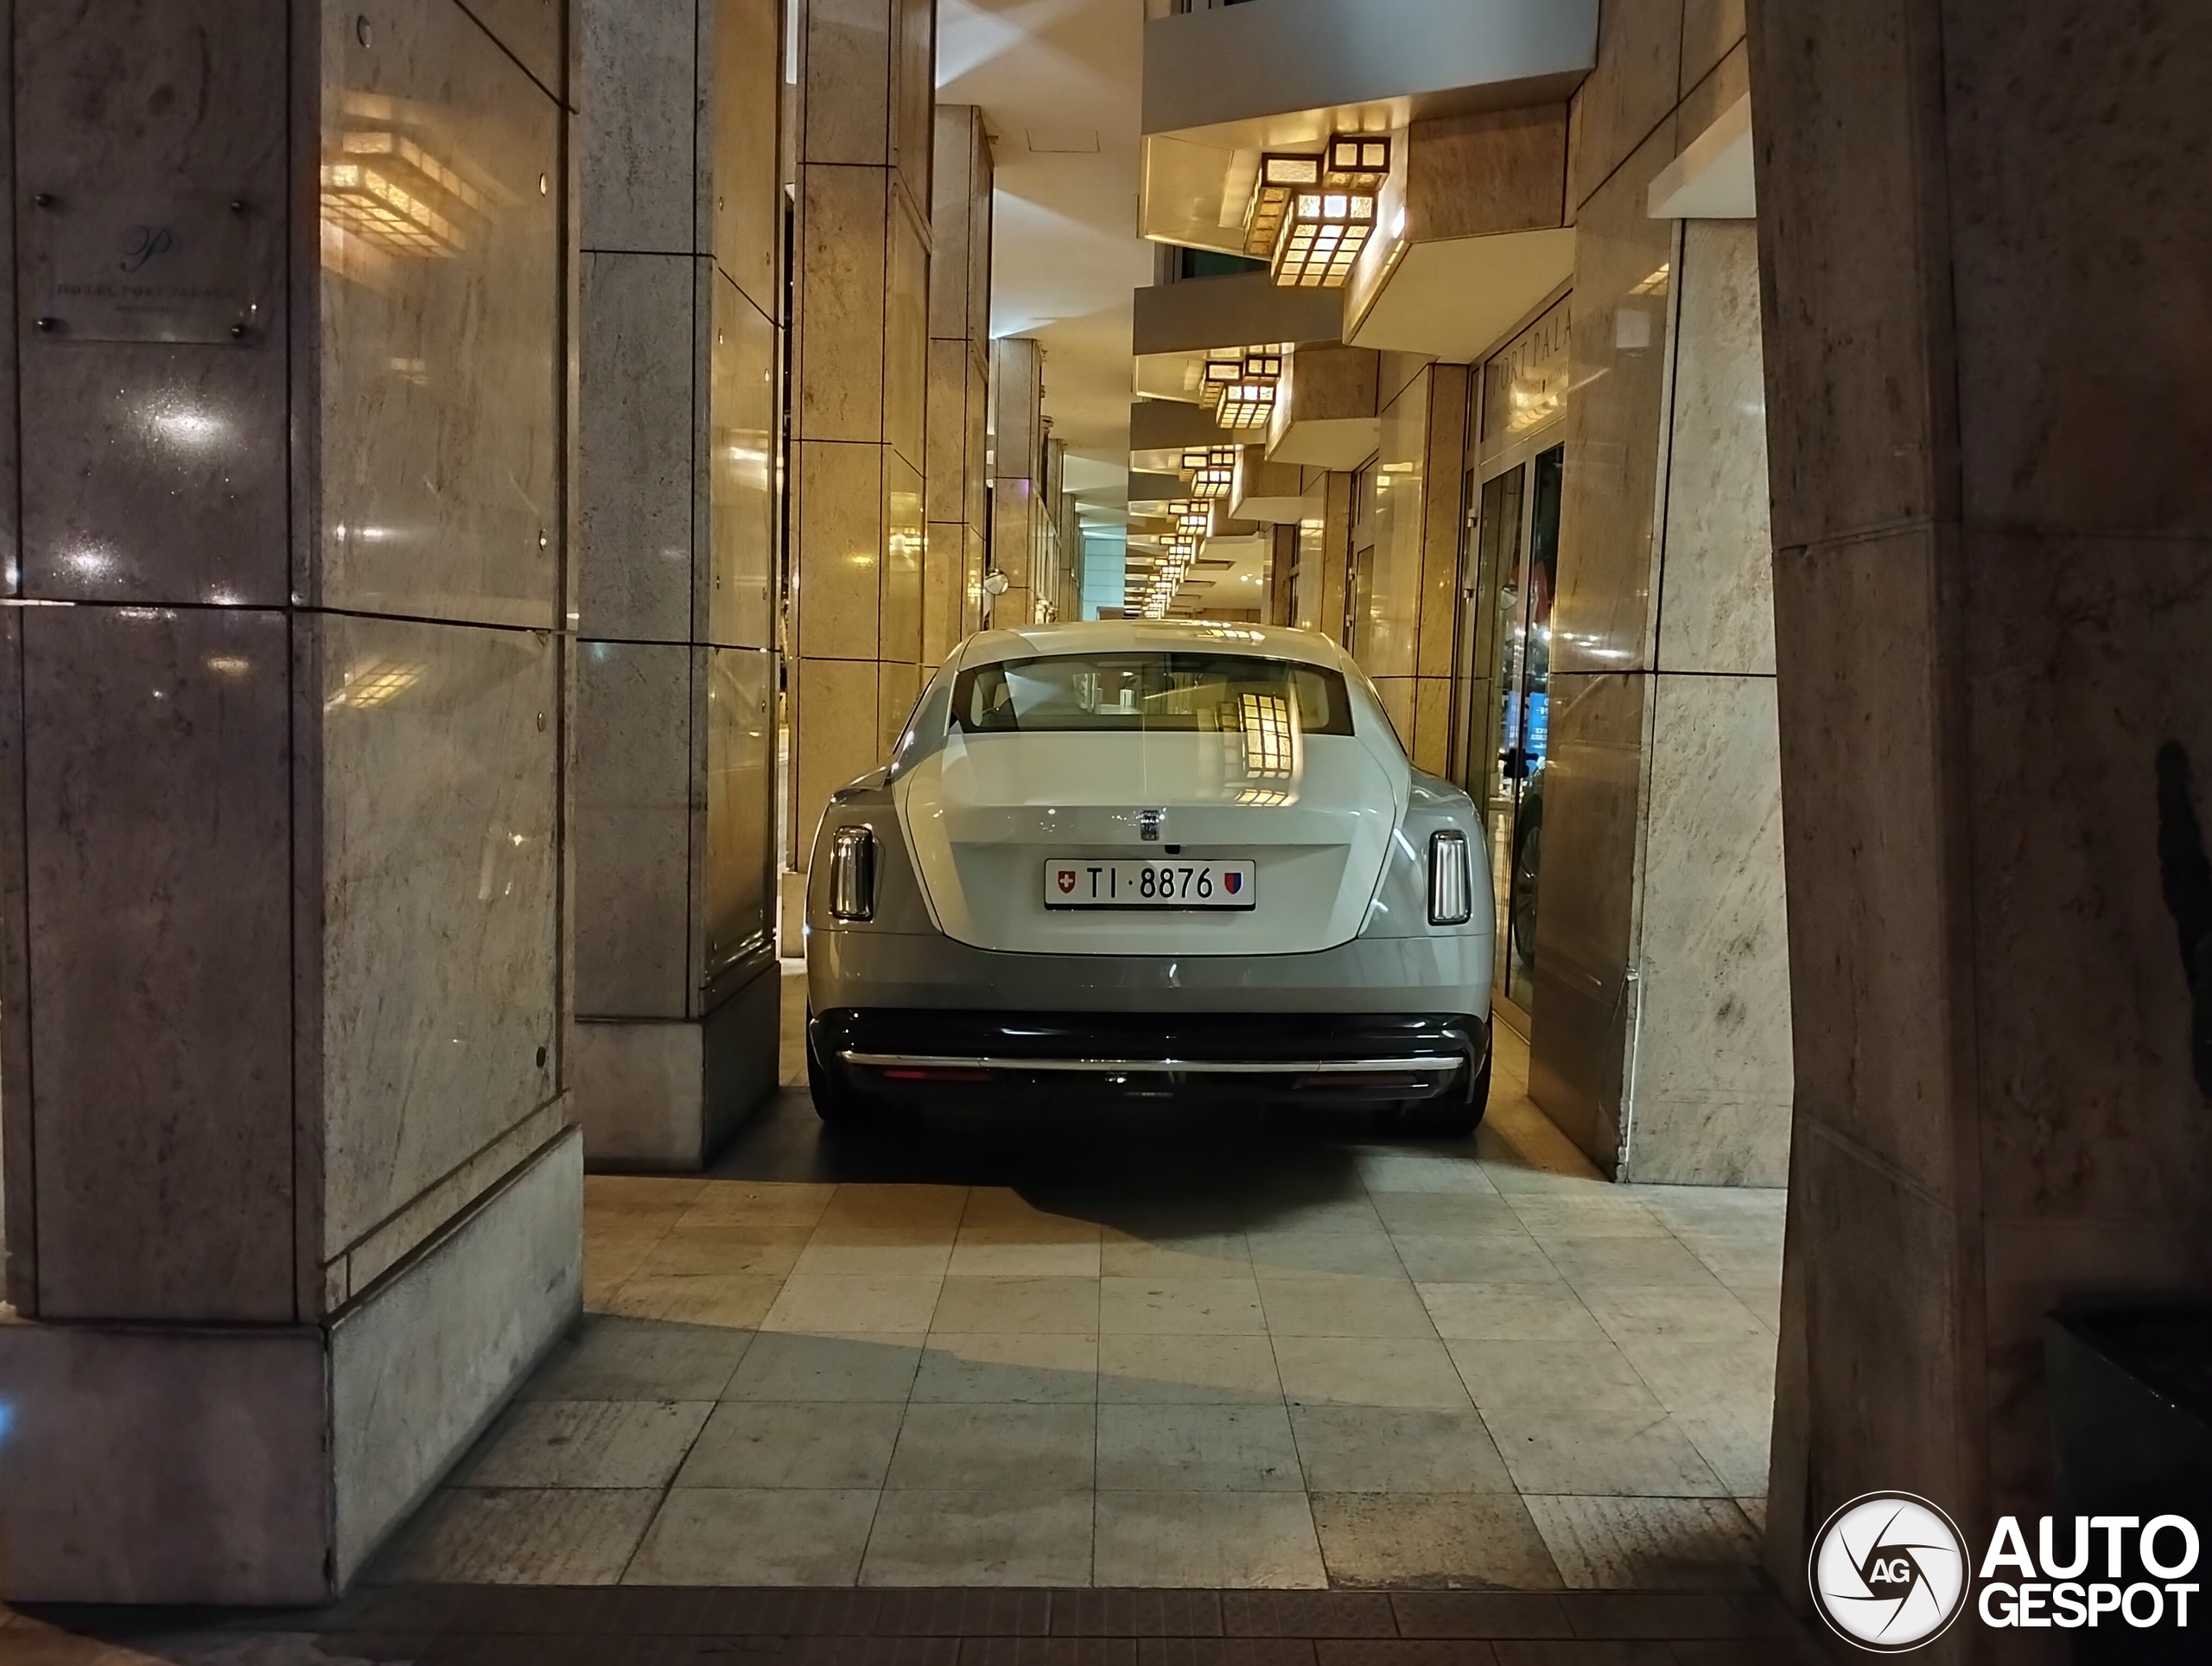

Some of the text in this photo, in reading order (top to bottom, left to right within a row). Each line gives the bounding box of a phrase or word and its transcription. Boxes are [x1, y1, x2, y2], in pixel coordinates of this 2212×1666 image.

[57, 283, 118, 296] HOTEL
[122, 285, 163, 298] PORT
[1492, 341, 1528, 397] PORT
